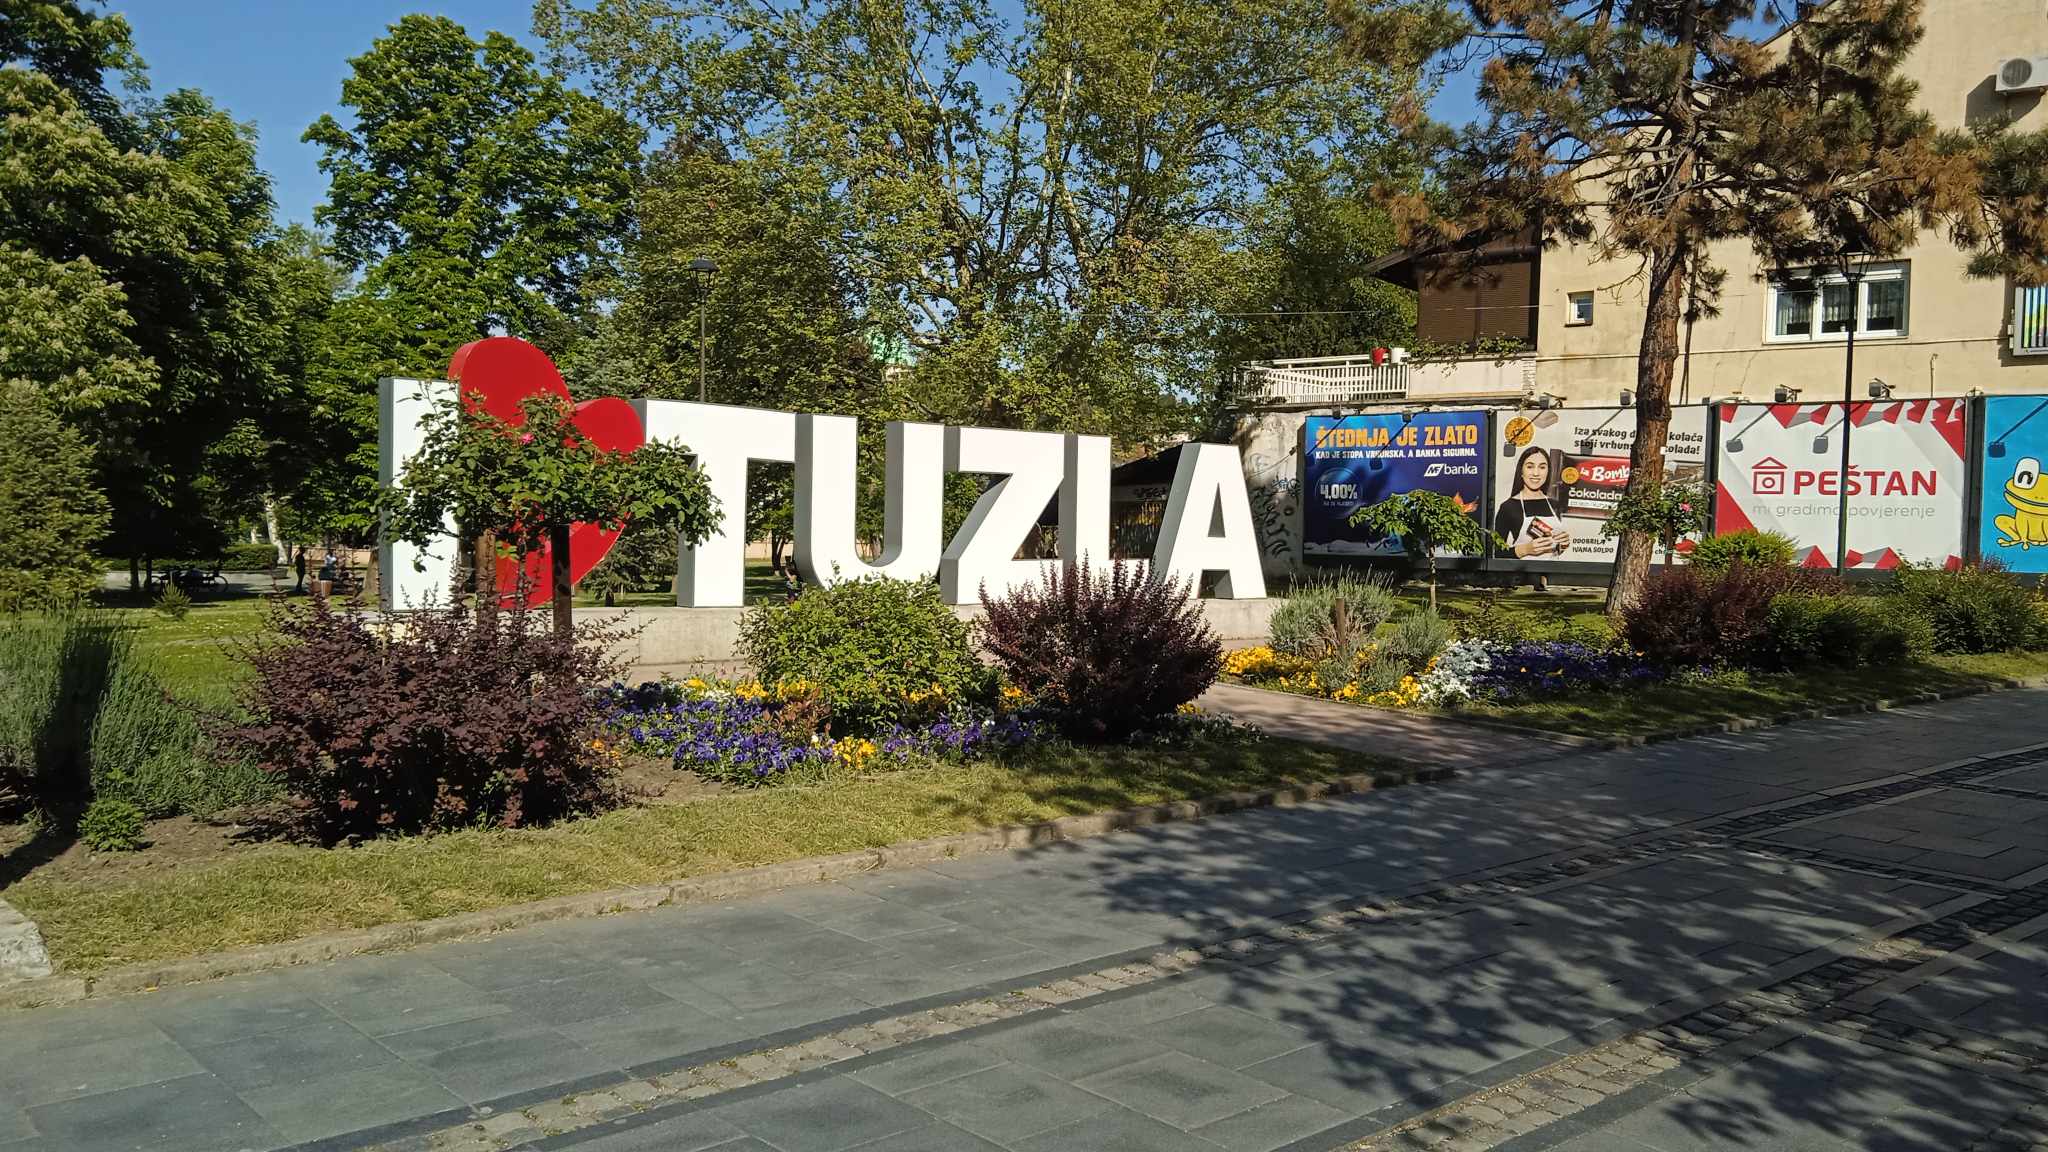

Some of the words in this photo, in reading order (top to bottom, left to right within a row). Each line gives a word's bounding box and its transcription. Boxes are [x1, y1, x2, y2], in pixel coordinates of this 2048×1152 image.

[1315, 426, 1389, 448] ŠTEDNJA
[1396, 426, 1418, 446] JE
[1424, 424, 1478, 446] ZLATO
[1575, 427, 1590, 436] Iza
[1592, 428, 1627, 440] svakog
[1669, 431, 1704, 442] kolača
[1575, 439, 1598, 449] stoji
[1342, 450, 1363, 459] STOPA
[1407, 449, 1414, 457] A
[1415, 449, 1441, 458] BANKA
[1444, 462, 1478, 475] banka
[1591, 465, 1630, 482] Bomb
[1793, 464, 1938, 497] PEŠTAN
[1568, 487, 1623, 501] čokolada
[632, 397, 1268, 609] TUZLA
[1752, 503, 1771, 514] mi
[1849, 505, 1936, 520] povjerenje
